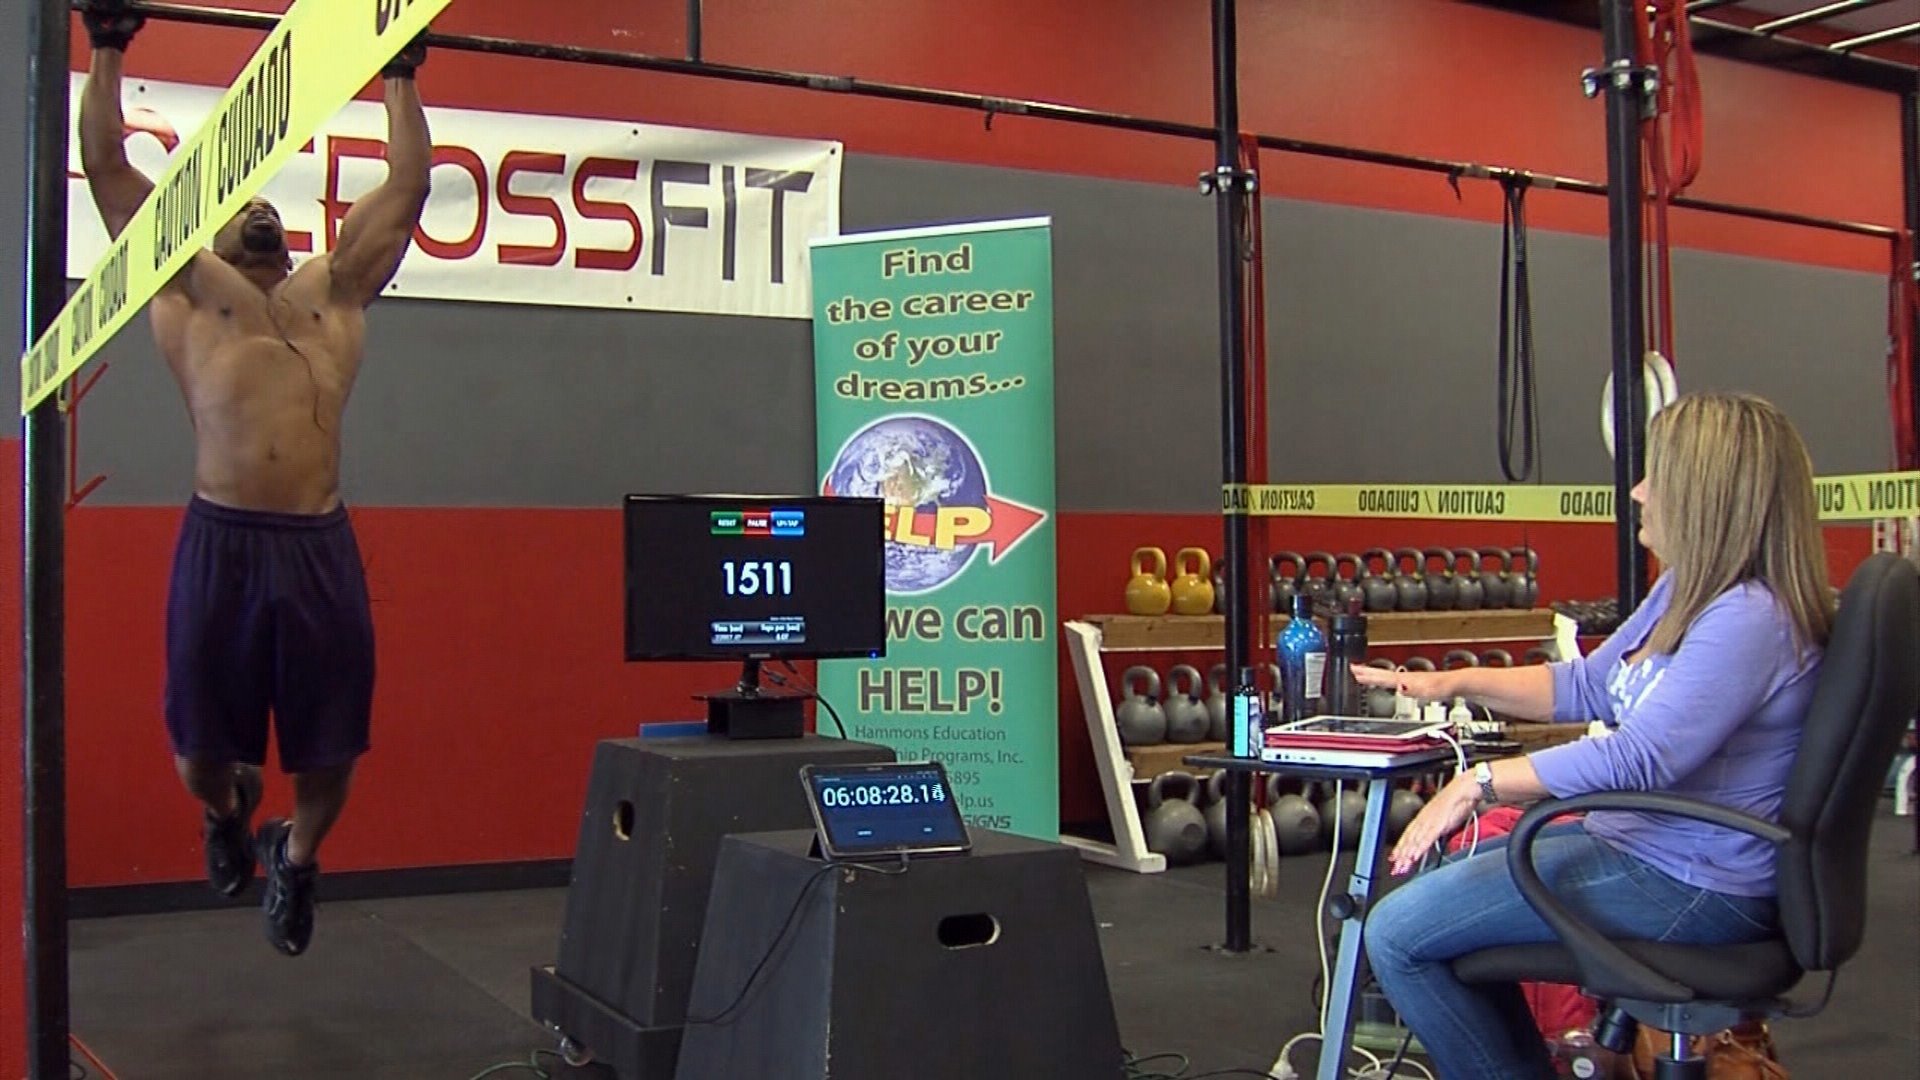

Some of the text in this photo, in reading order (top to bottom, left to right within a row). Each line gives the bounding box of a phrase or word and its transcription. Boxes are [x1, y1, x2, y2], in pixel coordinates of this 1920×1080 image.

[154, 138, 203, 271] CAUTION
[217, 29, 292, 205] CUIDADO
[287, 135, 814, 284] ROSSFIT
[884, 245, 971, 277] Find
[828, 291, 1032, 321] the career
[856, 333, 1001, 365] of your
[837, 374, 1023, 400] dreams...
[723, 562, 791, 595] 1511
[886, 607, 1043, 639] we can
[860, 670, 1001, 713] HELP!
[855, 725, 1006, 740] Hammons Education
[922, 749, 994, 766] Programs,
[998, 750, 1024, 763] Inc.
